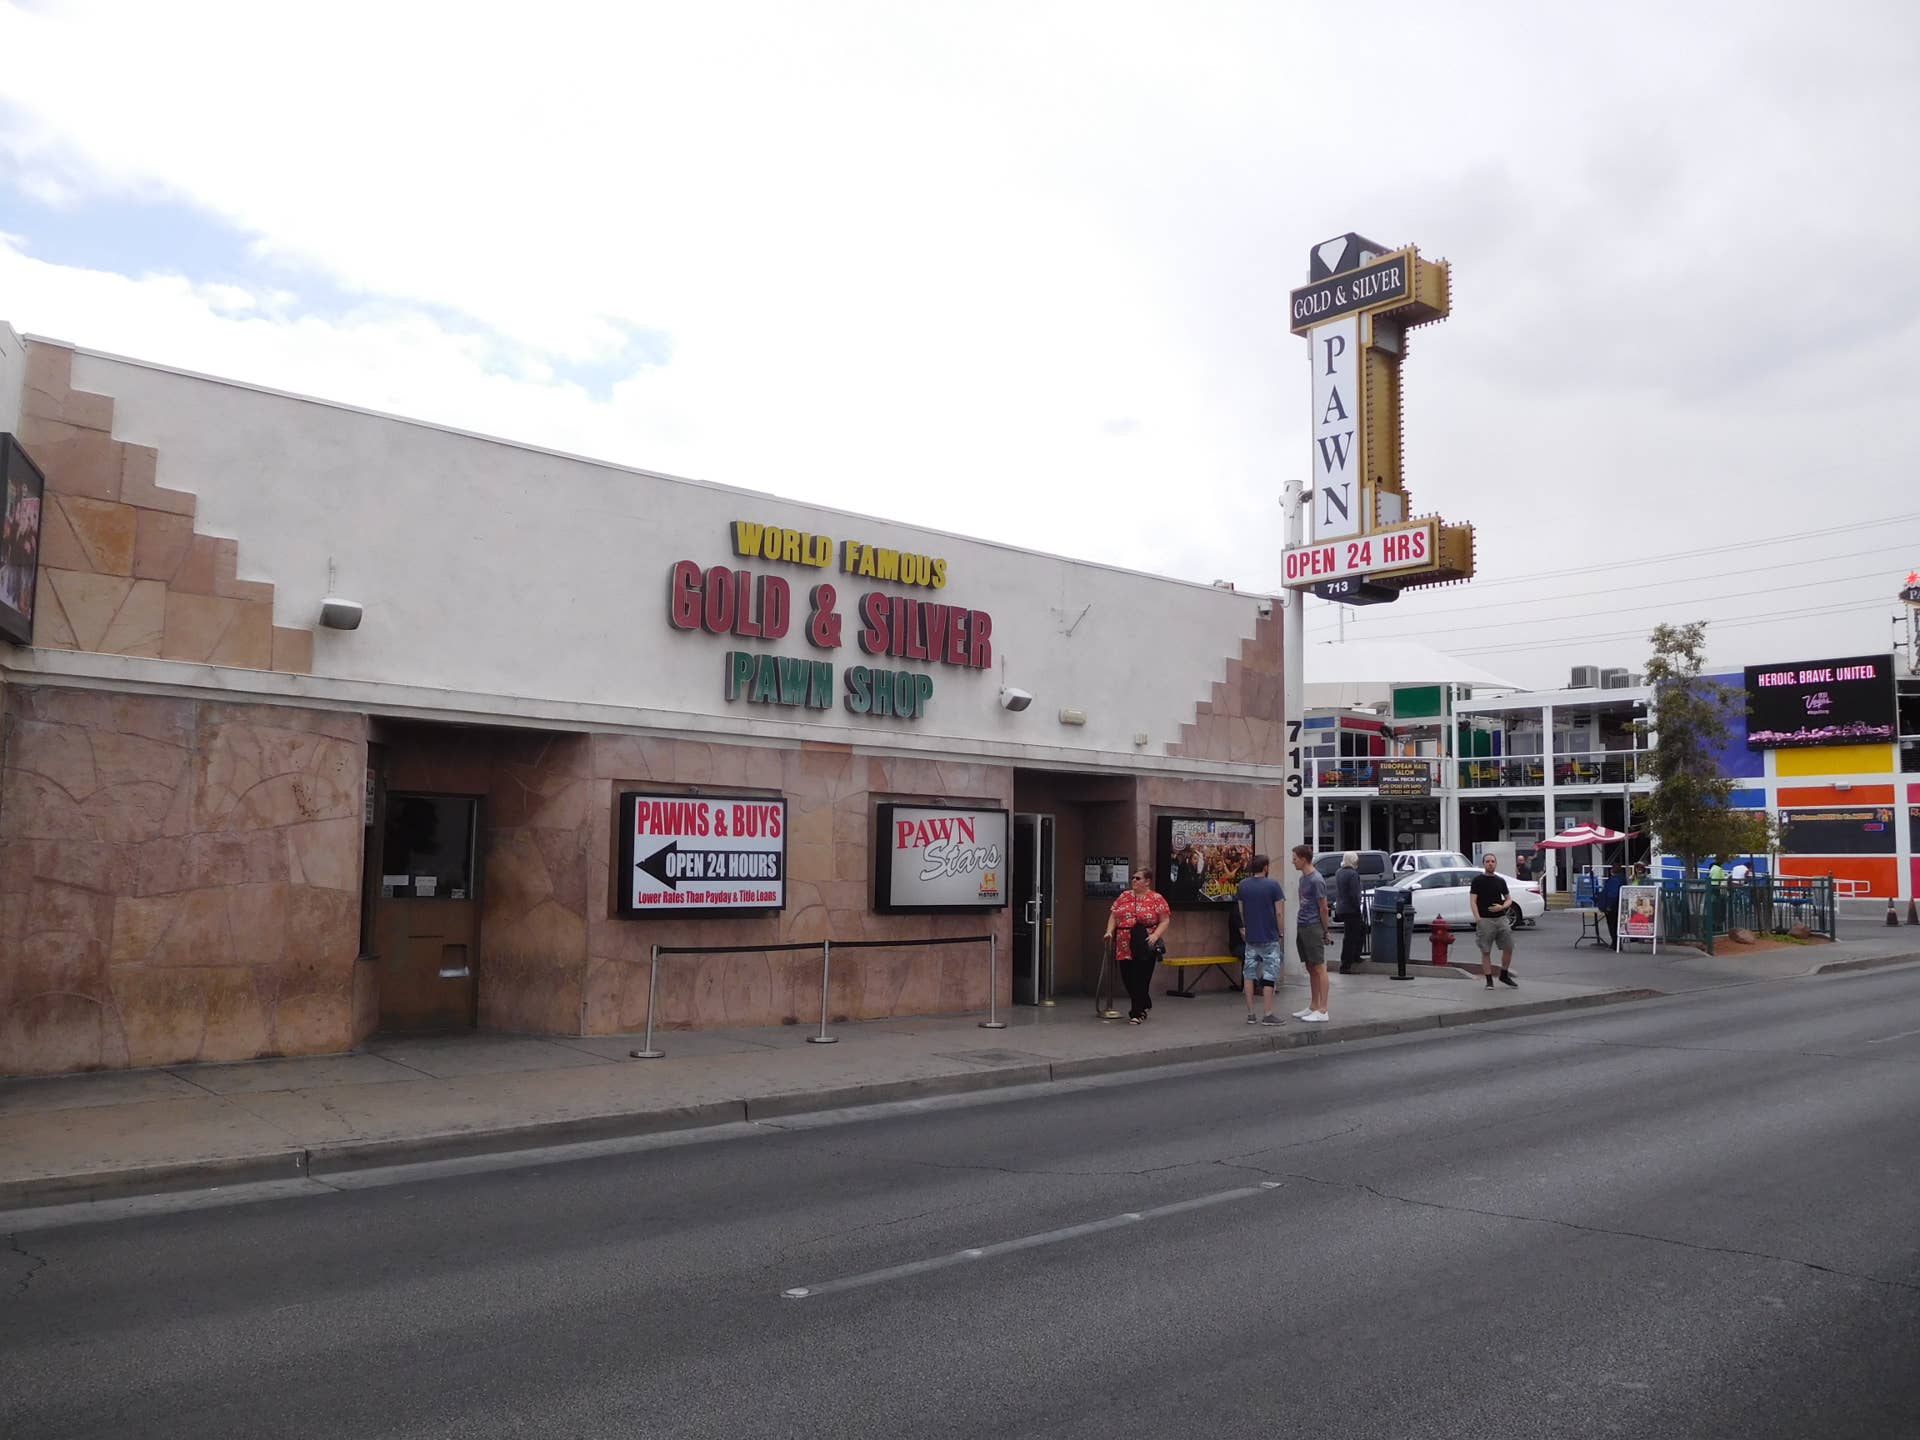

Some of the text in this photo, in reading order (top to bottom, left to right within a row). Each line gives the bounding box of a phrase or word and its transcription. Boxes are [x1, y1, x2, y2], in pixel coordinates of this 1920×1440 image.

[1294, 266, 1401, 319] GOLD & SILVER
[1317, 334, 1354, 525] PAWN
[731, 520, 947, 590] WORLD FAMOUS
[1286, 531, 1426, 580] OPEN 24 HRS
[1327, 580, 1349, 594] 713
[669, 560, 993, 670] GOLD & SILVER
[725, 651, 934, 720] PAWN SHOP
[1758, 665, 1876, 687] HEROIC. BRAVE. UNITED.
[1286, 720, 1302, 798] 713
[637, 800, 781, 838] PAWNS & BUYS
[896, 816, 976, 849] PAWN
[665, 852, 777, 879] OPEN 24 HOURS
[920, 839, 1001, 881] Stars
[638, 890, 777, 905] Lower Rates Than Payday & Title Loans
